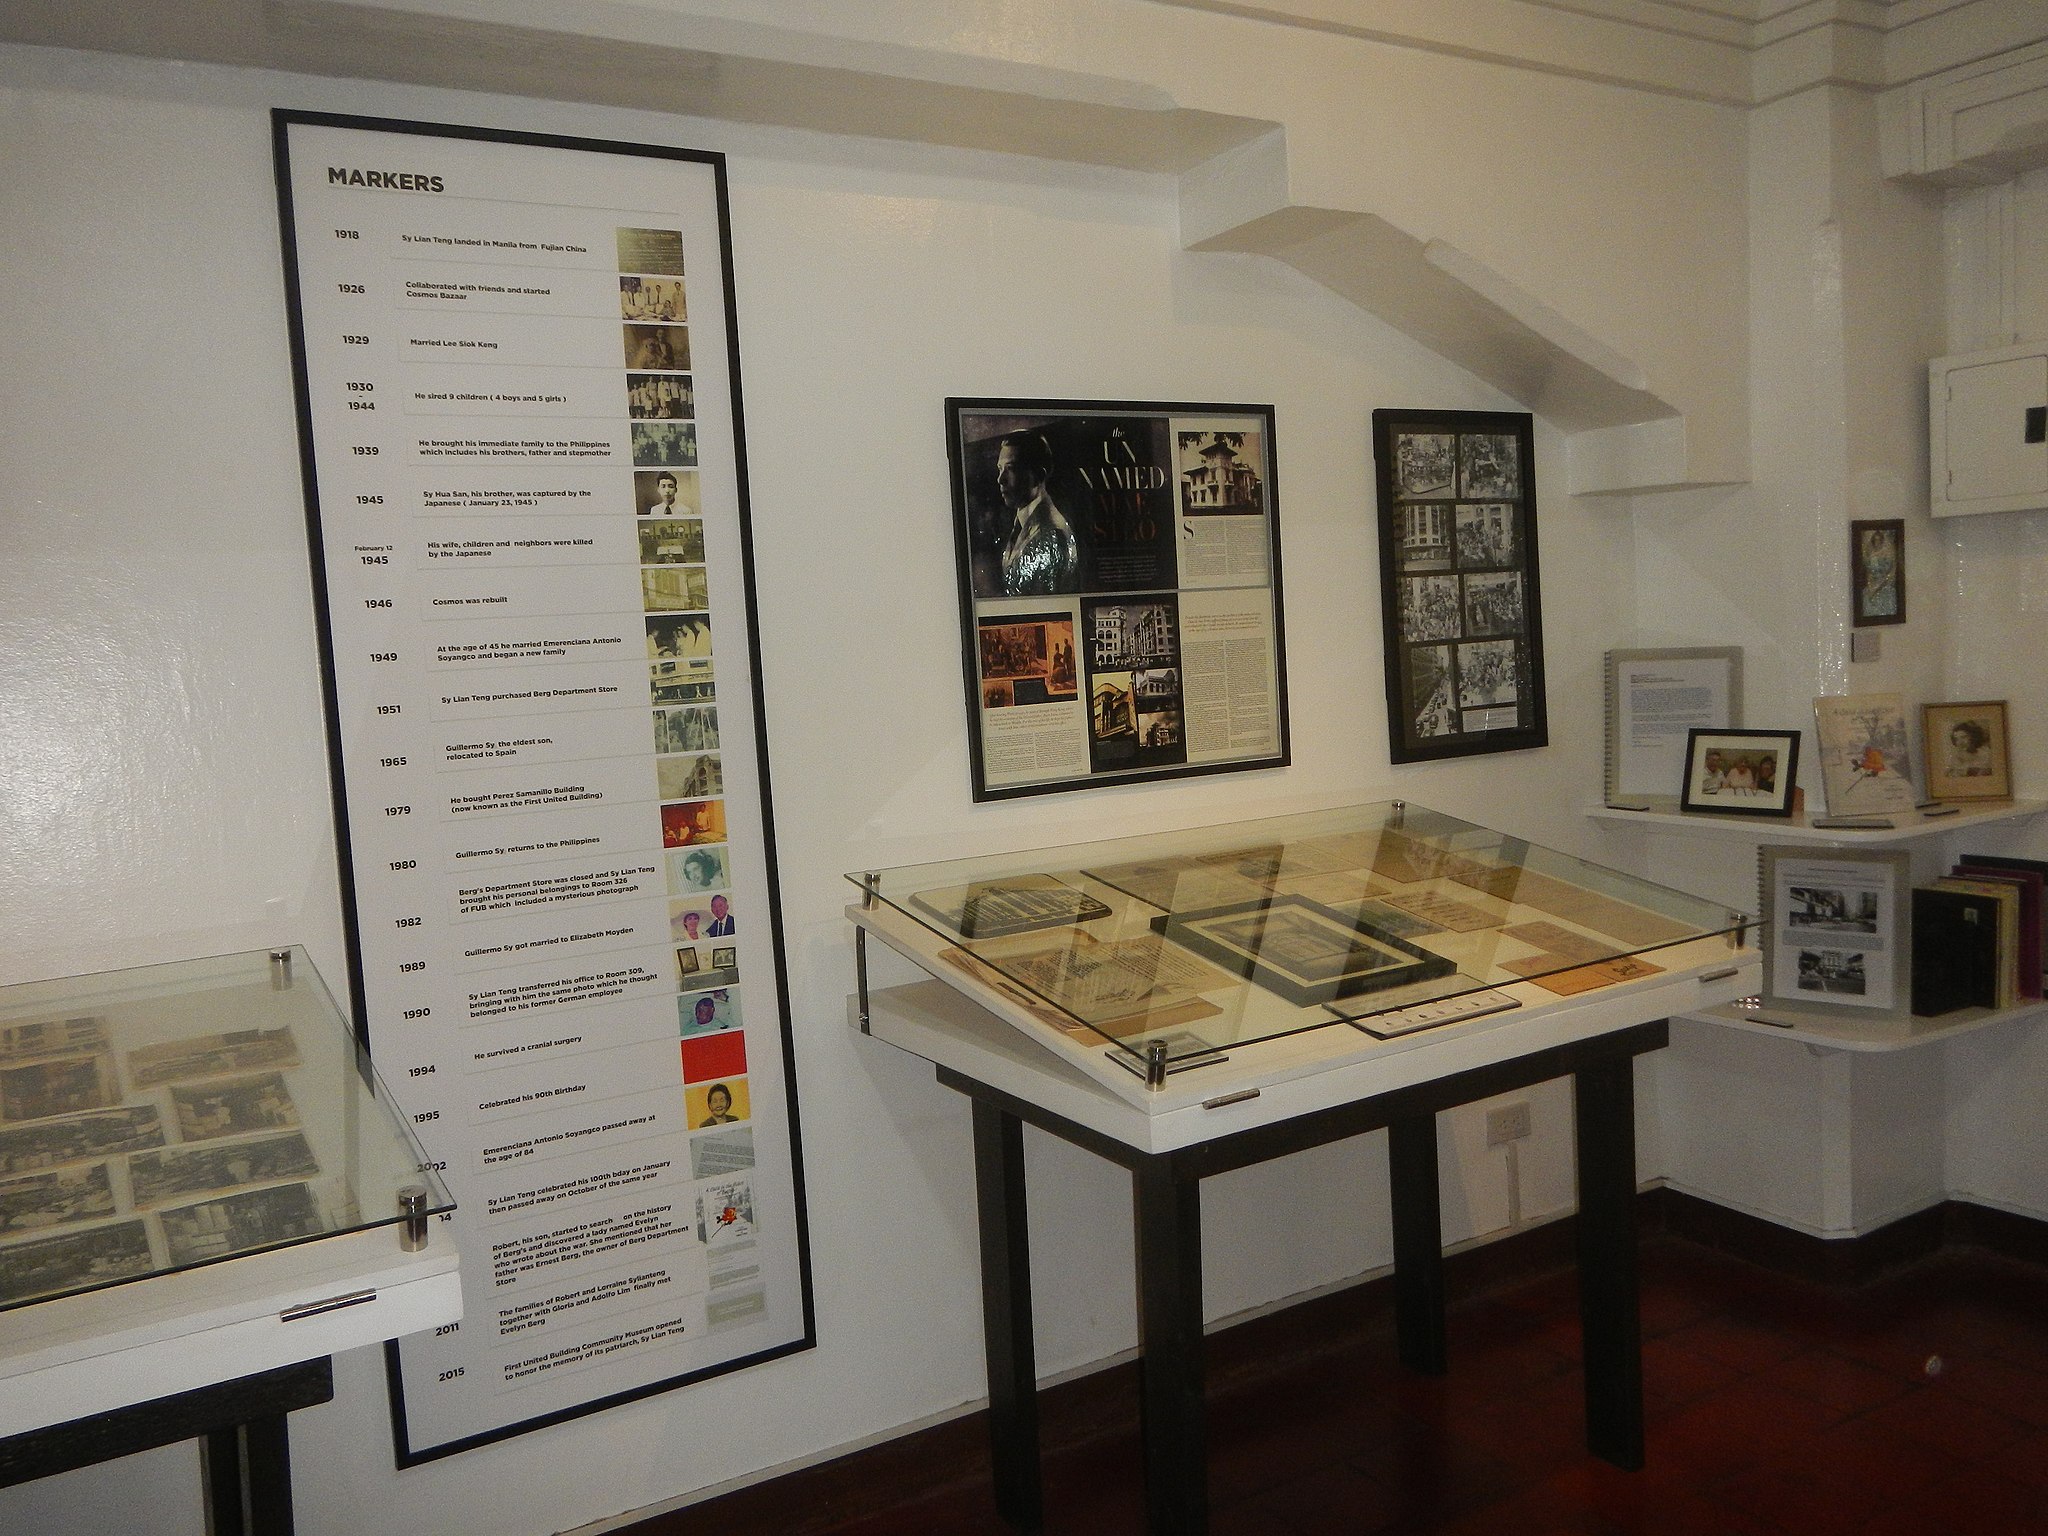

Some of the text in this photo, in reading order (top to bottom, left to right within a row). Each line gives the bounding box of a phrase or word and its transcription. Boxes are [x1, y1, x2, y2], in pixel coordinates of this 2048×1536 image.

[328, 166, 444, 193] MARKERS
[334, 229, 359, 240] 1918
[401, 234, 412, 243] Sy
[413, 235, 431, 243] Lian
[432, 236, 453, 245] Teng
[453, 237, 481, 246] landed
[491, 240, 517, 248] Manila
[518, 241, 537, 249] from
[540, 243, 564, 251] Fujian
[565, 245, 587, 253] China
[338, 283, 365, 294] 1926
[405, 280, 457, 290] Collaborated
[477, 284, 505, 293] friends
[522, 287, 550, 295] started
[406, 290, 467, 300] Cosmos Bazaar
[342, 334, 369, 345] 1929
[410, 338, 441, 346] Married
[477, 341, 498, 349] Keng
[346, 382, 374, 392] 1930
[348, 401, 375, 410] 1944
[1112, 427, 1126, 438] the
[431, 439, 463, 447] brought
[520, 440, 544, 448] family
[569, 440, 610, 448] Philippines
[352, 446, 379, 455] 1939
[419, 448, 443, 456] which
[444, 448, 477, 456] includes
[1103, 440, 1138, 465] UN
[1078, 466, 1166, 490] NAMED
[356, 495, 383, 504] 1945
[1183, 520, 1195, 541] S
[462, 540, 494, 548] children
[513, 539, 552, 547] neighbors
[361, 555, 388, 565] 1945
[455, 550, 492, 558] Japanese
[365, 599, 392, 608] 1946
[432, 598, 463, 606] Cosmos
[370, 652, 397, 662] 1949
[441, 696, 451, 704] Sy
[452, 695, 470, 703] Lian
[491, 691, 532, 701] purchased
[552, 687, 596, 696] Department
[377, 704, 401, 715] 1951
[380, 756, 407, 767] 1965
[462, 794, 491, 803] bought
[492, 792, 514, 800] Perez
[515, 788, 552, 797] Samanillo
[553, 785, 584, 794] Building
[450, 806, 471, 814] (now
[542, 795, 568, 804] United
[569, 792, 603, 801] Building)
[384, 805, 411, 816] 1979
[455, 849, 493, 859] Guillermo
[507, 844, 535, 852] returns
[559, 837, 600, 846] Philippines
[389, 859, 417, 871] 1980
[395, 916, 421, 928] 1982
[464, 946, 502, 957] Guillermo
[503, 944, 513, 952] Sy
[514, 942, 528, 951] got
[529, 936, 559, 947] married
[569, 931, 604, 941] Elizabeth
[605, 927, 634, 936] Moyden
[399, 960, 426, 973] 1989
[470, 1005, 507, 1018] belonged
[517, 1002, 529, 1010] his
[530, 999, 556, 1008] former
[557, 994, 586, 1003] German
[587, 988, 623, 998] employee
[403, 1007, 431, 1019] 1990
[486, 1046, 519, 1058] survived
[526, 1040, 553, 1050] cranial
[553, 1036, 582, 1046] surgery
[408, 1064, 435, 1077] 1994
[478, 1096, 521, 1110] Celebrated
[534, 1090, 553, 1099] 90th
[554, 1084, 586, 1095] Birthday
[413, 1110, 439, 1123] 1995
[482, 1140, 532, 1156] Emerenciana
[533, 1133, 564, 1145] Antonio
[564, 1126, 601, 1138] Soyangco
[601, 1119, 627, 1132] passed
[628, 1116, 647, 1125] away
[498, 1153, 512, 1161] age
[513, 1150, 522, 1158] of
[523, 1148, 534, 1156] 84
[416, 1160, 446, 1173] 2002
[498, 1309, 513, 1317] The
[514, 1301, 544, 1313] families
[545, 1297, 553, 1305] of
[554, 1290, 580, 1303] Robert
[581, 1286, 596, 1296] and
[597, 1279, 627, 1292] Lorraine
[435, 1322, 459, 1337] 2011
[500, 1318, 545, 1335] Evelyn Berg
[503, 1317, 682, 1372] First United Building Community Museum opened
[438, 1366, 464, 1382] 2015
